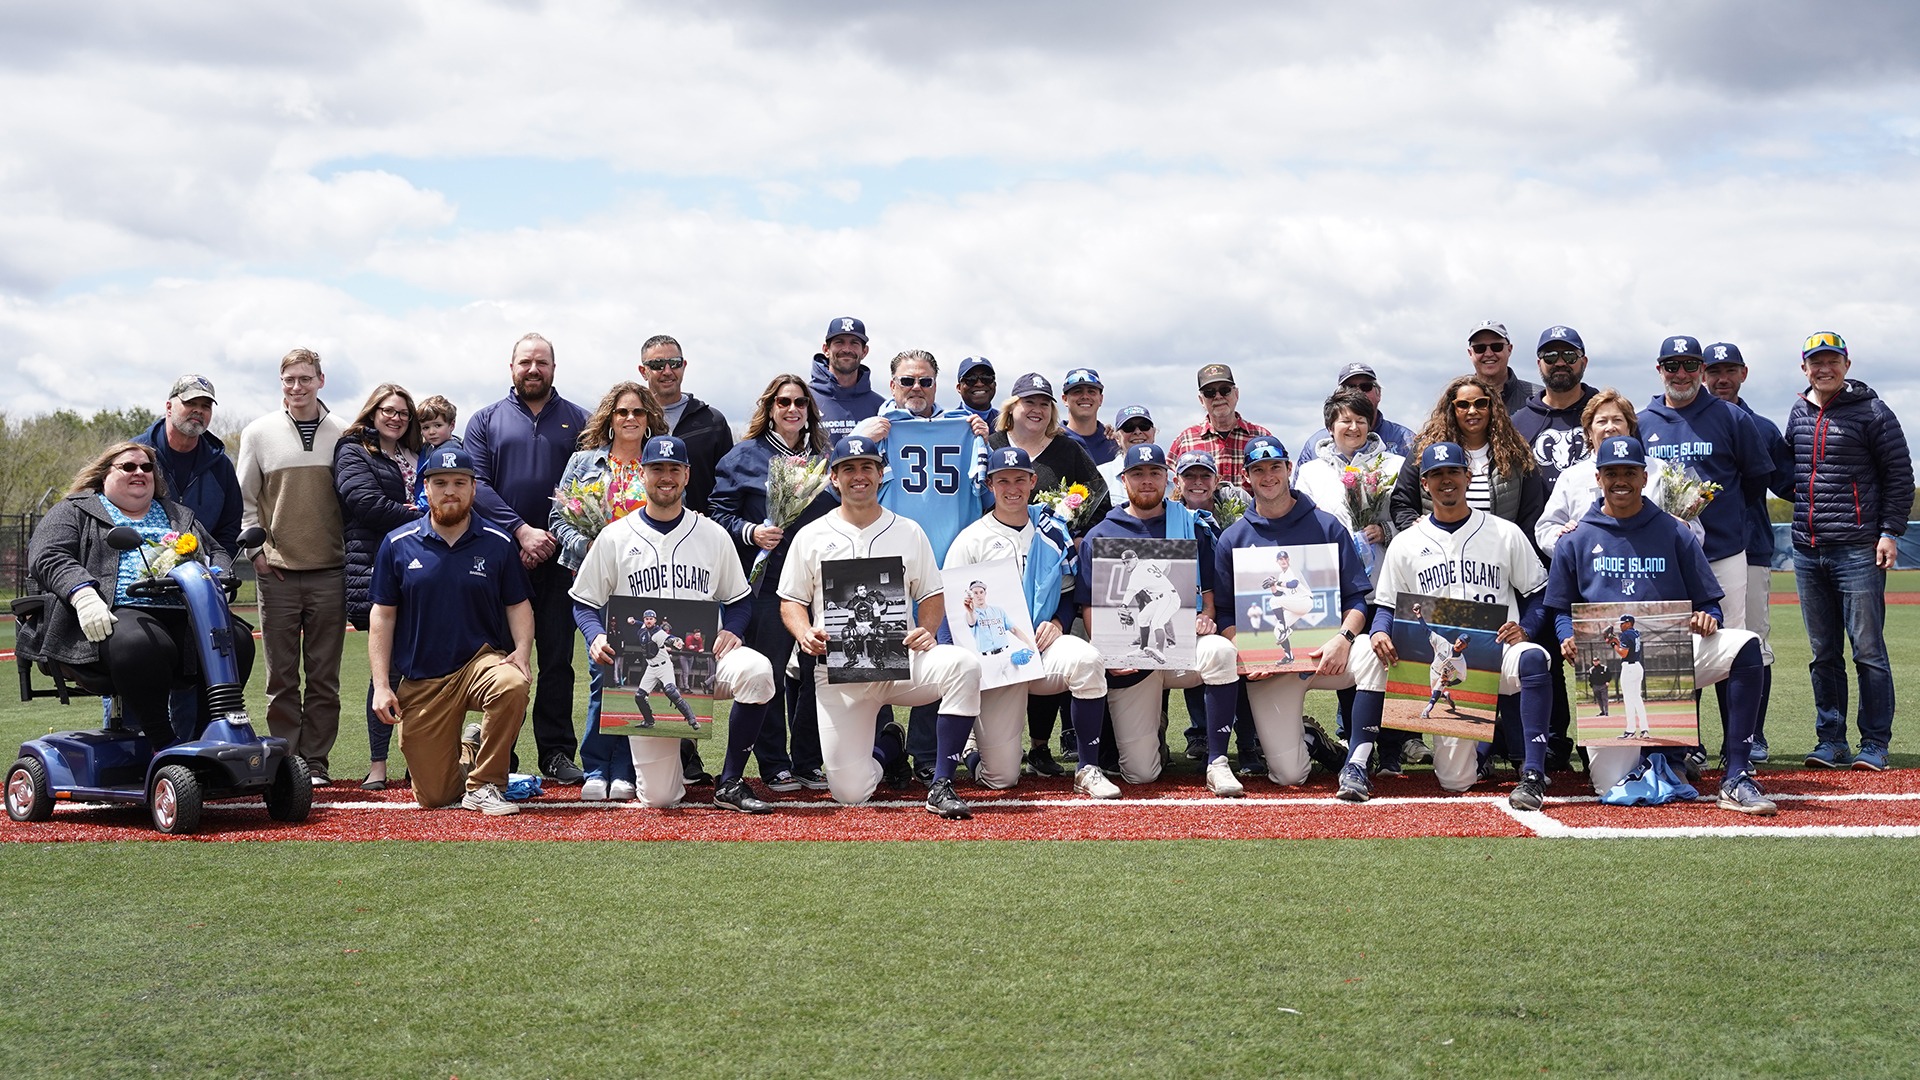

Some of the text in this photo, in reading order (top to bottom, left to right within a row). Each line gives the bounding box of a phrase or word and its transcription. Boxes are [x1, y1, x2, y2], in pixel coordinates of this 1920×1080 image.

[846, 420, 862, 428] ISLA
[1648, 442, 1713, 459] RHODE ISLAND
[900, 445, 961, 495] 35
[1418, 559, 1501, 594] RHODE ISLAND
[1593, 556, 1665, 573] RHODE ISLAND
[627, 564, 711, 597] RHODE ISLAND
